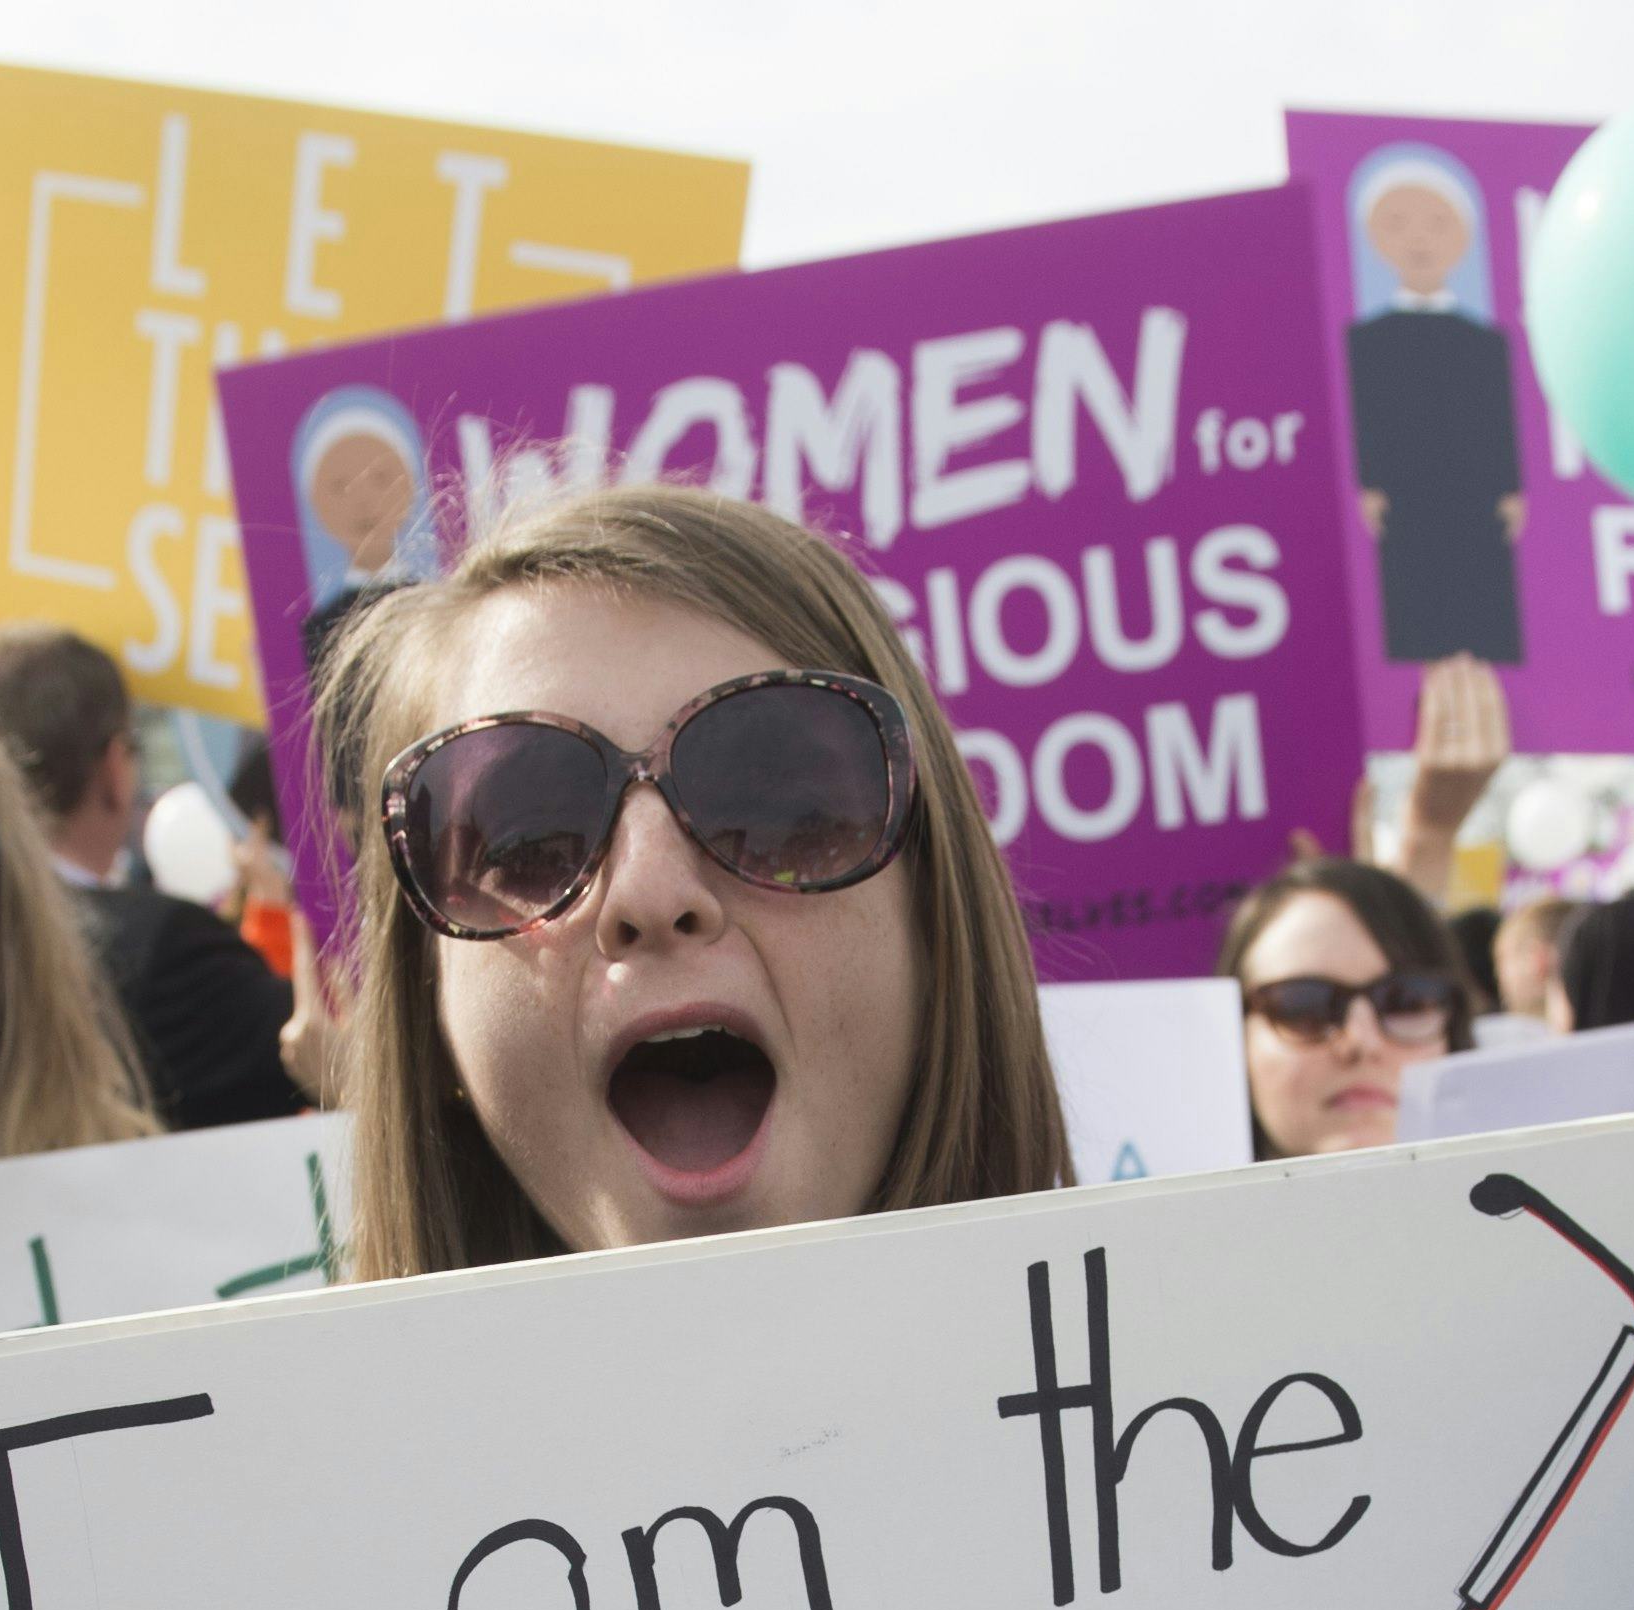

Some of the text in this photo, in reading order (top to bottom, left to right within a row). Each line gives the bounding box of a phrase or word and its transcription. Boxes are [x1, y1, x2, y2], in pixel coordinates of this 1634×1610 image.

[151, 112, 509, 323] LET
[456, 305, 1189, 551] WOMEN
[1196, 406, 1305, 475] for
[996, 1245, 1371, 1606] the
